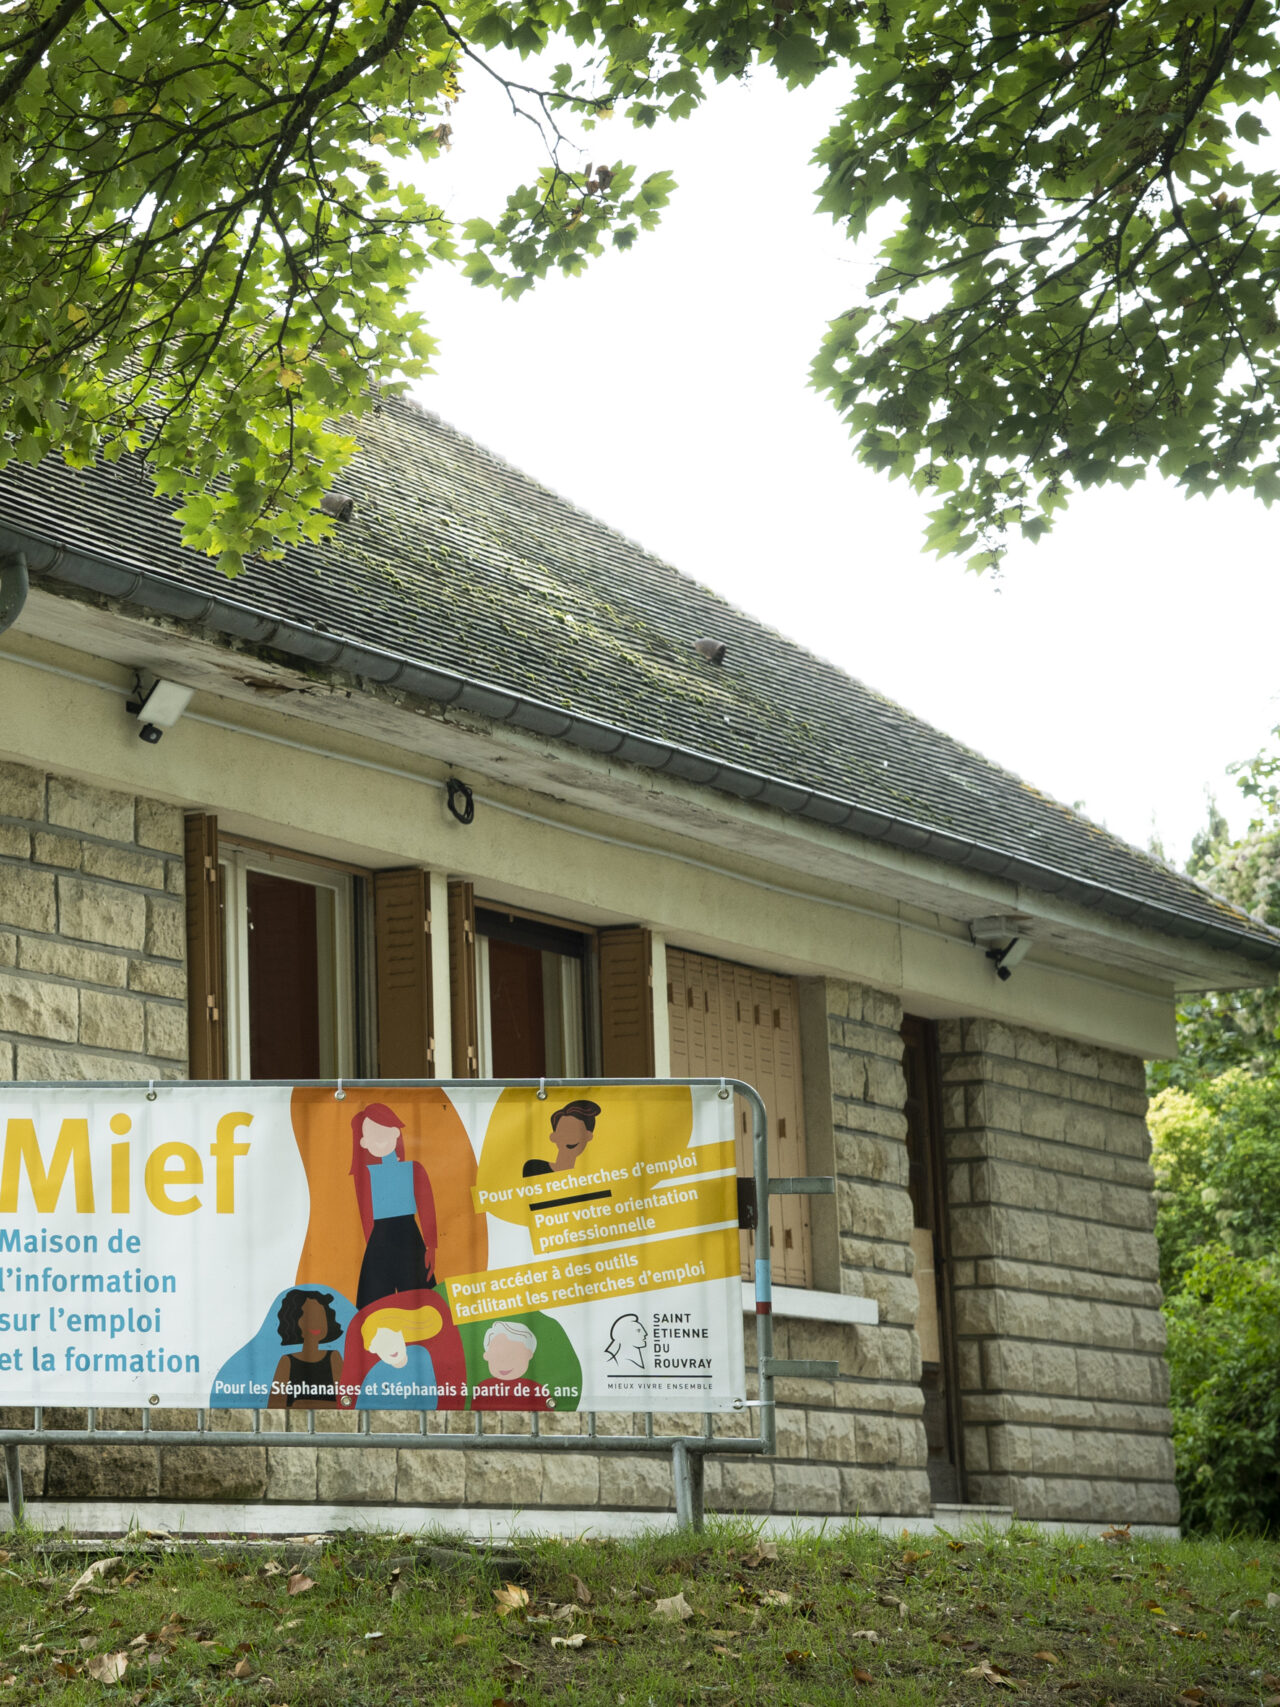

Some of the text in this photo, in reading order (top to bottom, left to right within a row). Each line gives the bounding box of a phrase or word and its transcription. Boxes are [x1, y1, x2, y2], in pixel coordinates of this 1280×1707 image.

[478, 1152, 698, 1205] Pour vos recherches d'emploi
[534, 1188, 699, 1228] Pour votre orientation
[108, 1228, 141, 1253] de
[539, 1216, 656, 1251] professionnelle
[451, 1253, 639, 1298] Pour accéder à des outils
[455, 1260, 705, 1318] facilitant les recherches d'emploi
[49, 1307, 162, 1338] l'emploi
[653, 1313, 691, 1323] SAINT
[32, 1347, 55, 1372] la
[65, 1347, 200, 1373] formation
[654, 1343, 670, 1353] DU
[654, 1358, 712, 1368] ROUVRAY
[215, 1380, 579, 1400] Pour les Stéphanaises et Stéphanais à partir de 16 ans
